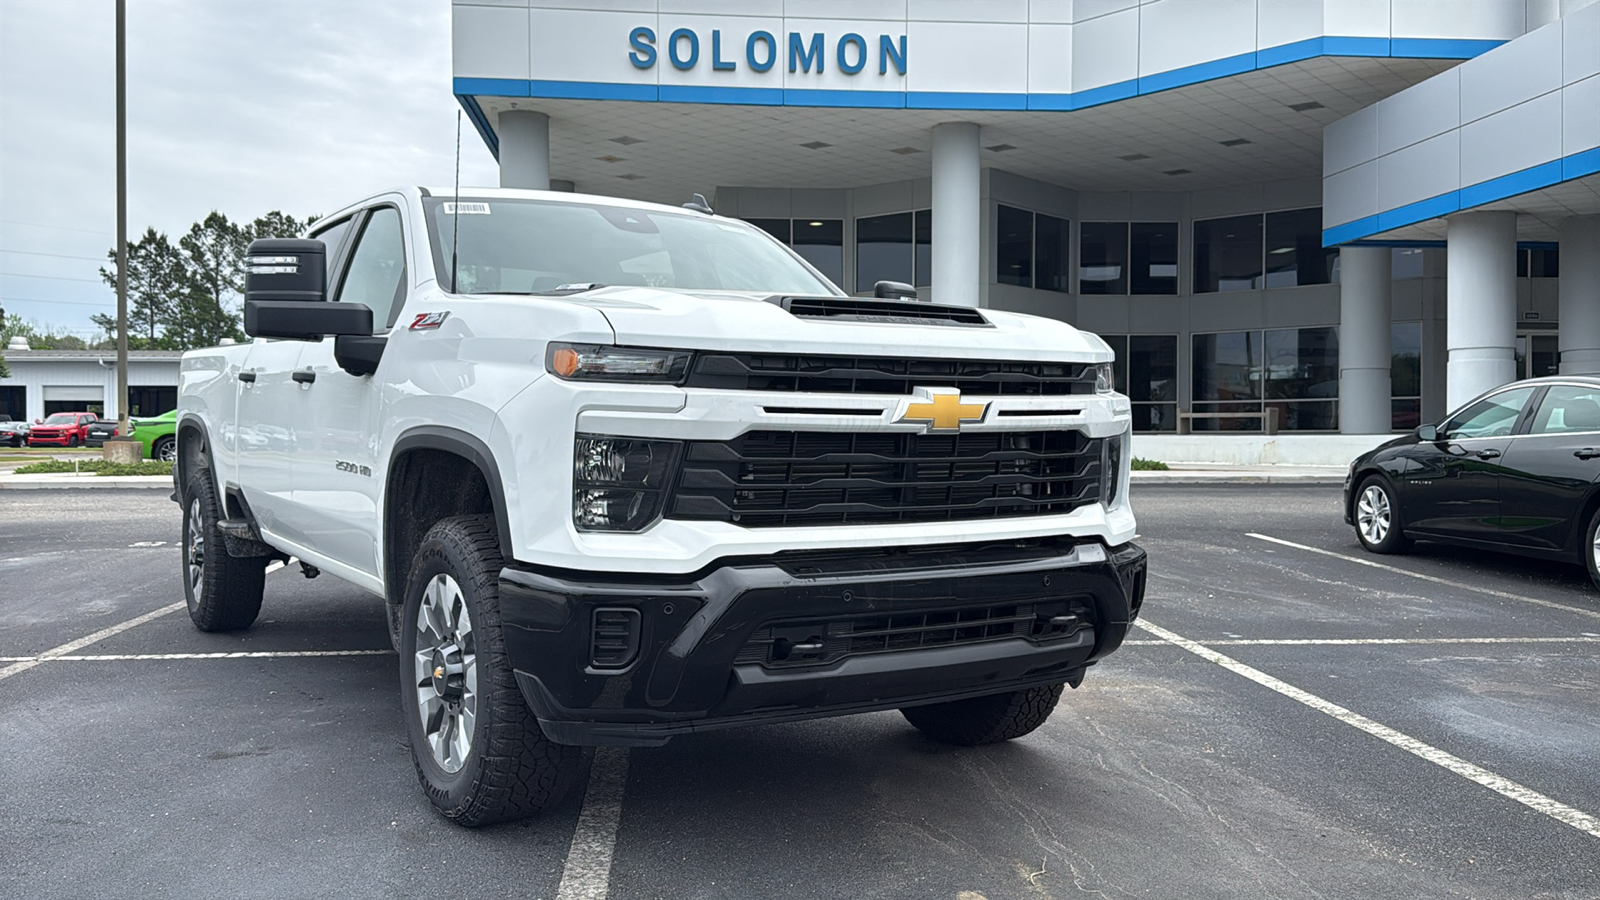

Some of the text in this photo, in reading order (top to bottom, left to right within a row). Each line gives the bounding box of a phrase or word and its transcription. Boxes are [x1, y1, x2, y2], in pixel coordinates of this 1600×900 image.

[628, 26, 907, 76] SOLOMON
[408, 311, 450, 332] Z71
[335, 460, 372, 477] 2500 HD
